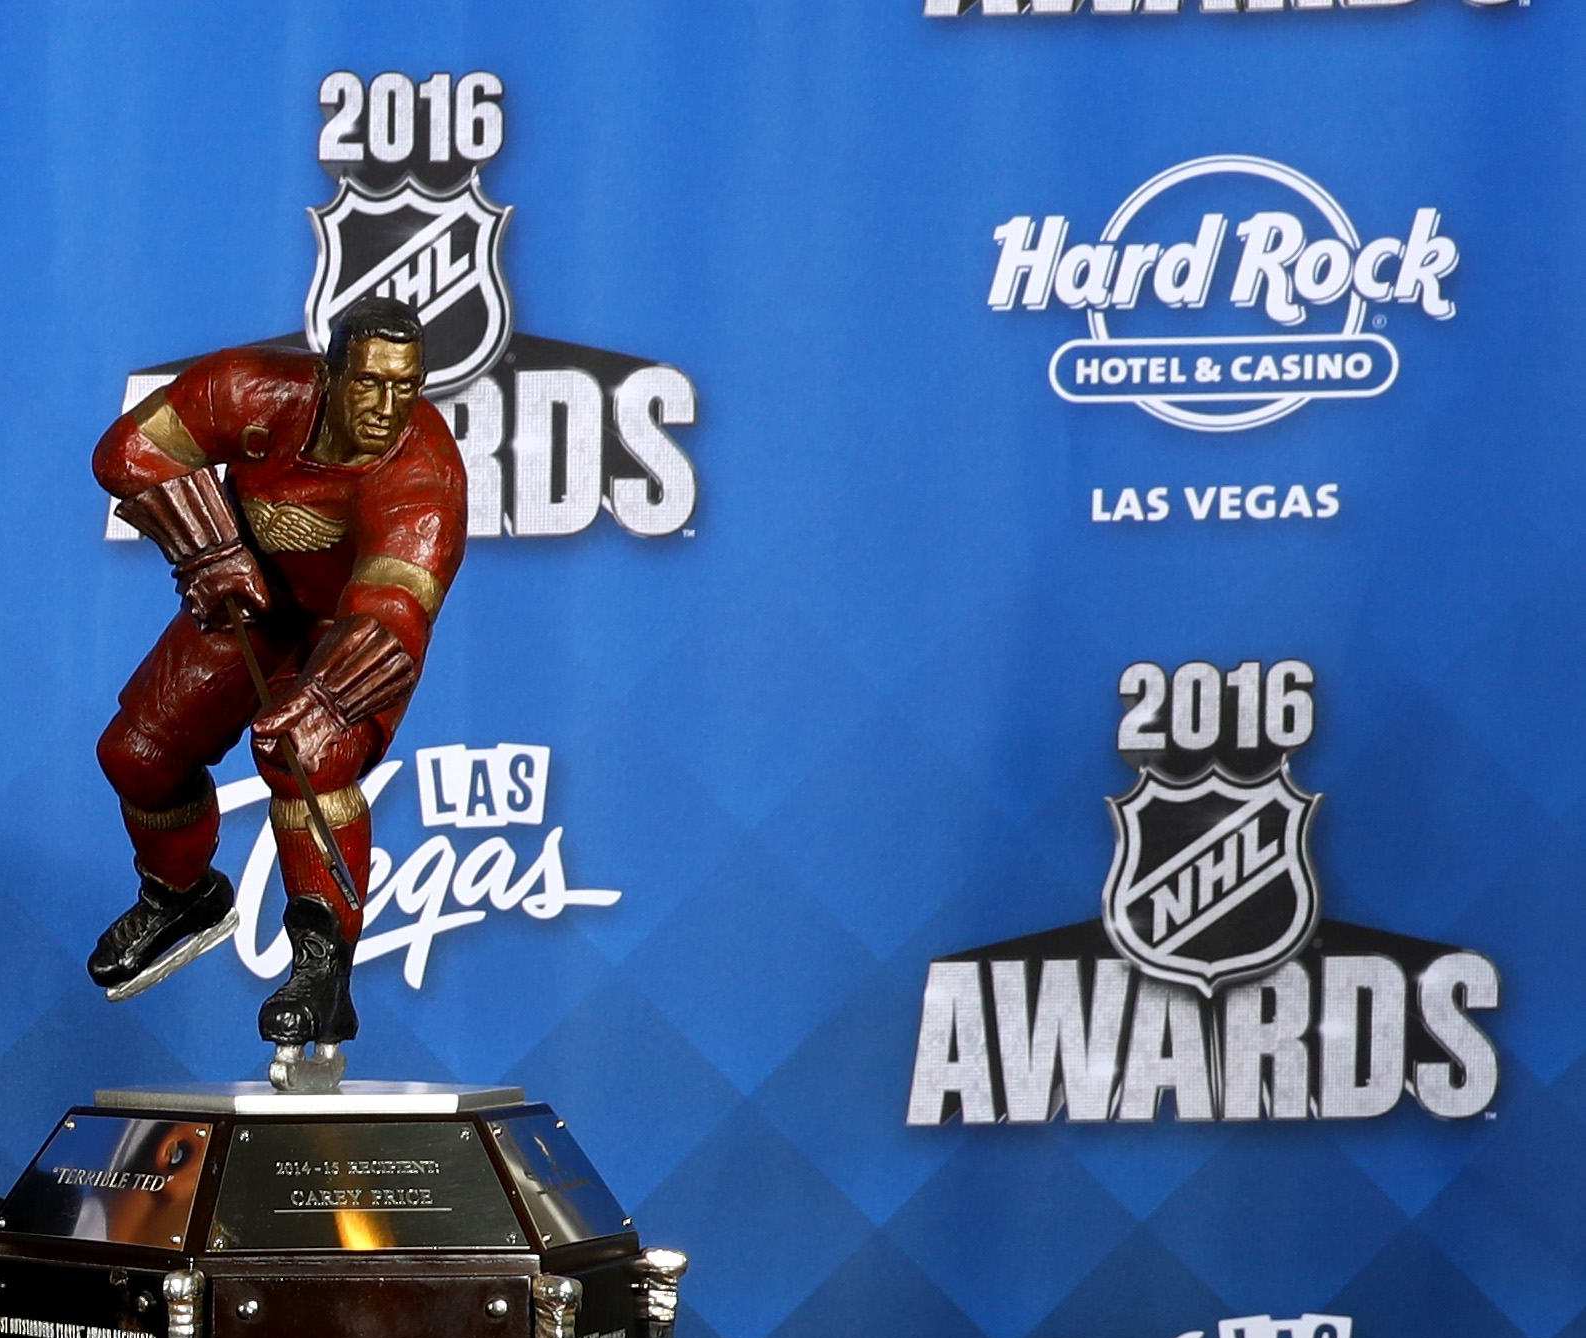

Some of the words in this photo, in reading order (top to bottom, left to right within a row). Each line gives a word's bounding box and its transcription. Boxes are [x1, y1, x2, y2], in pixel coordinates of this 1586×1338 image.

[318, 71, 505, 162] 2016
[376, 226, 469, 312] HL
[987, 214, 1225, 311] Hard
[1230, 208, 1459, 326] Rock
[1075, 357, 1186, 384] HOTEL
[1194, 357, 1221, 382] &
[1230, 353, 1372, 381] CASINO
[1092, 487, 1169, 521] LAS
[1185, 484, 1340, 520] VEGAS
[1118, 659, 1314, 751] 2016
[431, 752, 534, 818] LAS
[1150, 817, 1280, 942] NHL
[906, 950, 1499, 1124] AWARDS
[276, 1161, 340, 1175] 2014-15
[290, 1189, 362, 1206] CAREY
[370, 1188, 434, 1205] PRICE
